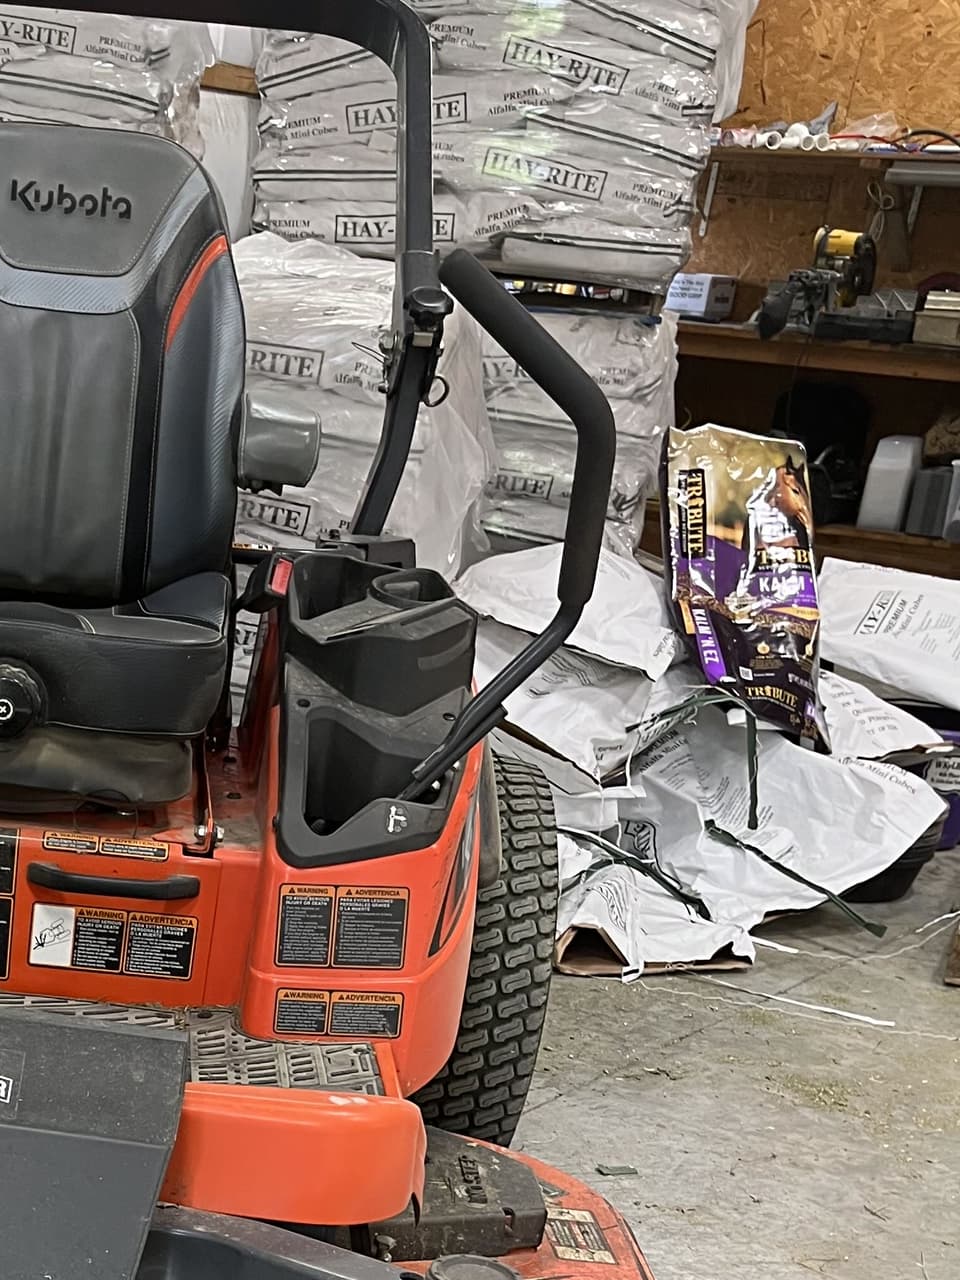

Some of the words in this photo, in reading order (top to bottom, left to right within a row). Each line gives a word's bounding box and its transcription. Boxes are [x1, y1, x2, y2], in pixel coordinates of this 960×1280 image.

[511, 43, 621, 89] HAY-RITE
[291, 131, 310, 140] Mini
[312, 127, 338, 138] Cubes
[491, 153, 600, 193] HAY-RITE
[10, 179, 132, 219] Kubota
[250, 349, 314, 378] RITE
[489, 475, 545, 494] -RITE
[241, 503, 301, 529] RITE
[692, 608, 708, 634] KALM
[704, 649, 719, 664] EZ
[866, 765, 888, 778] Mini
[889, 774, 916, 794] Cubes
[86, 909, 124, 920] WARNING
[140, 916, 194, 926] ADVERTENCIA
[290, 992, 325, 1000] WARNING
[345, 994, 396, 1003] ADVERTENCIA
